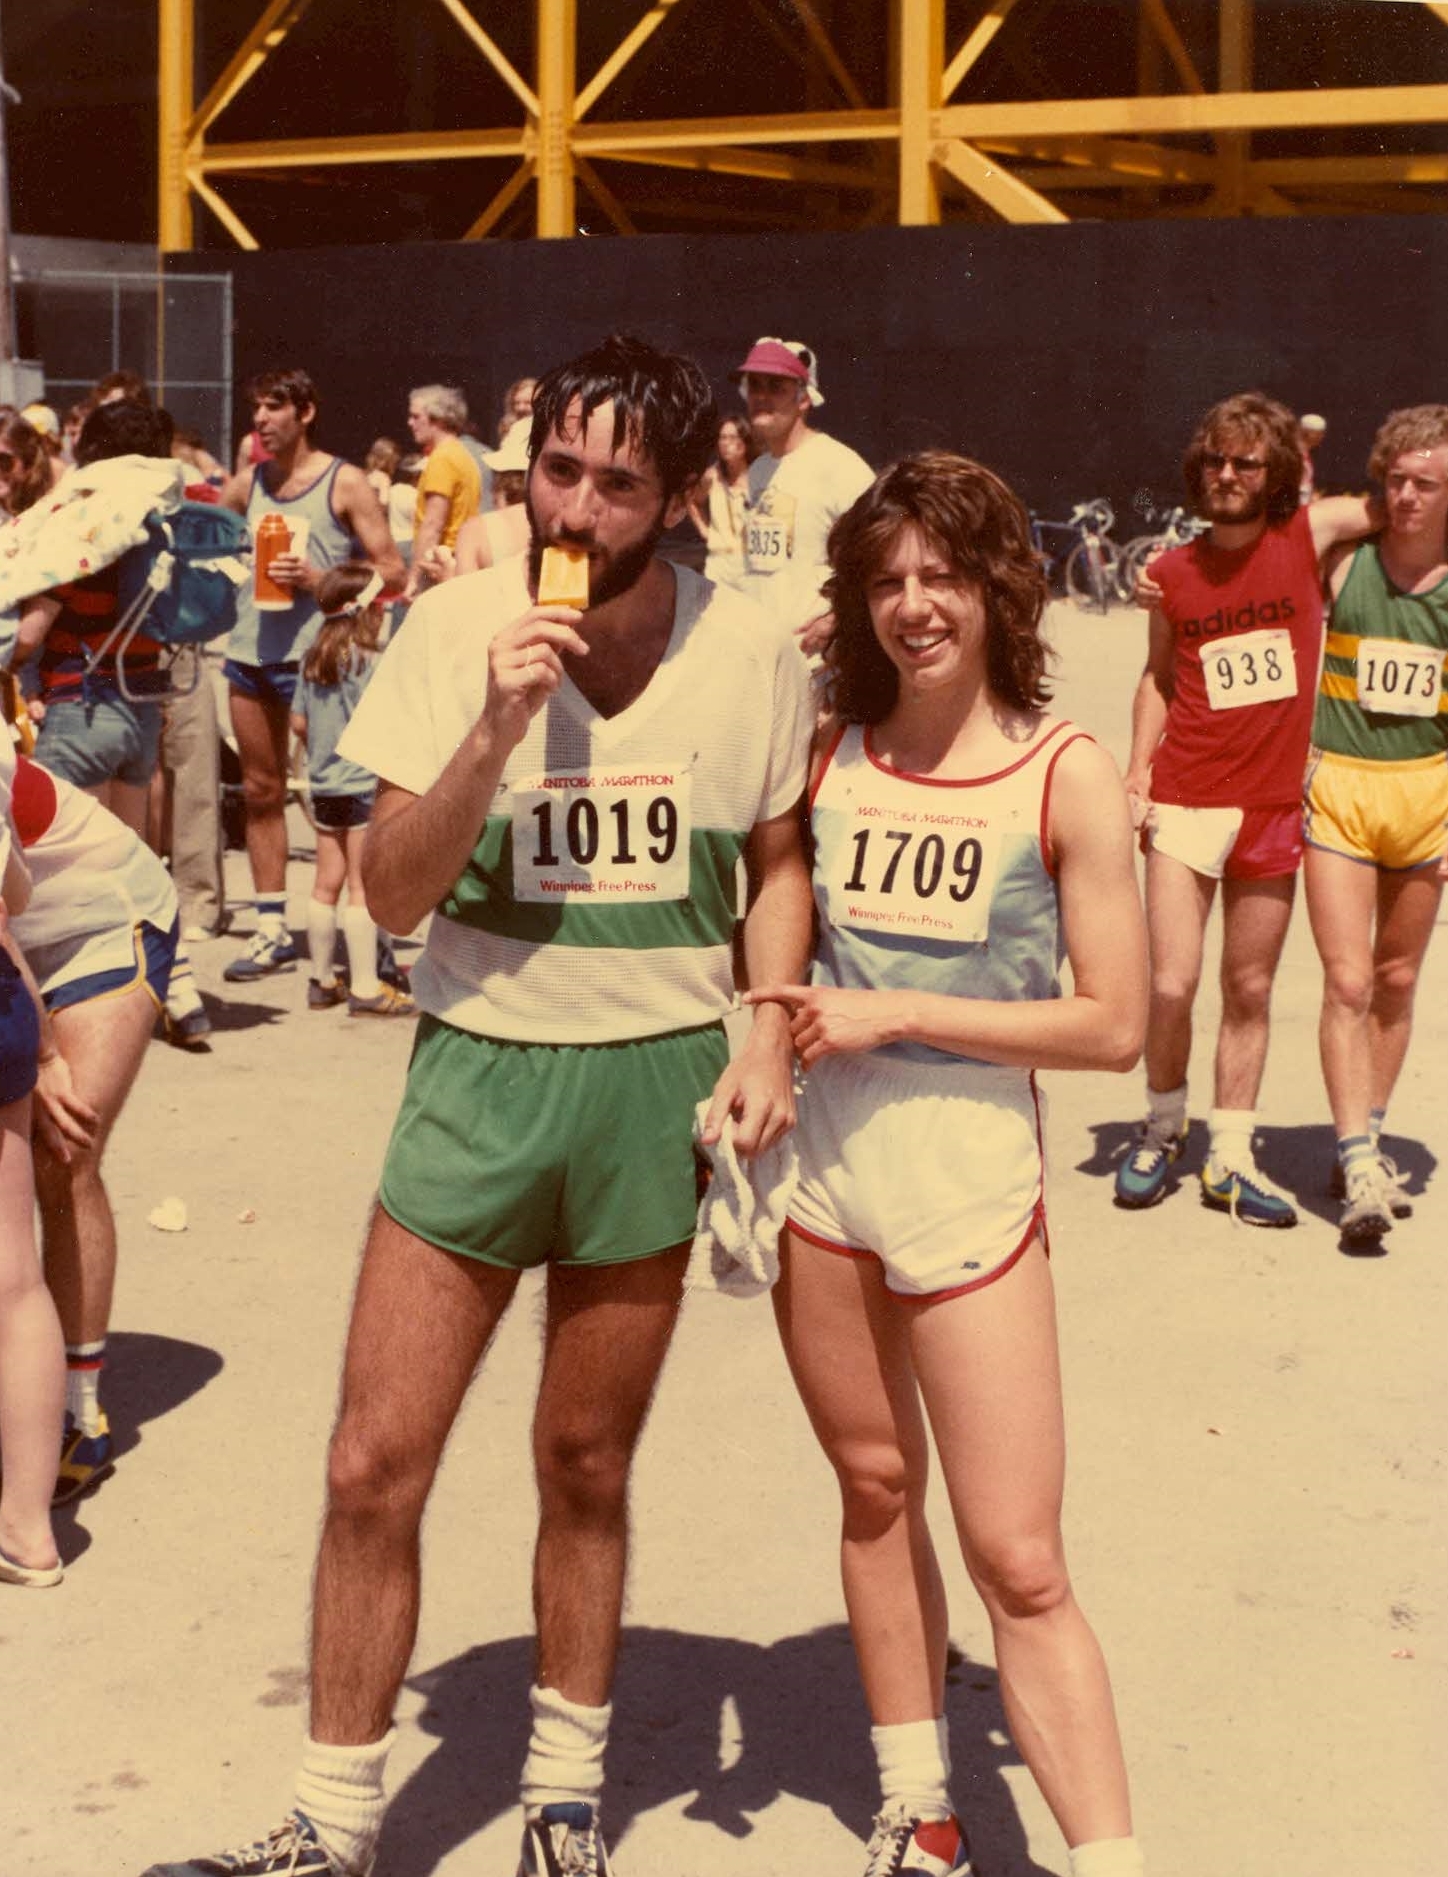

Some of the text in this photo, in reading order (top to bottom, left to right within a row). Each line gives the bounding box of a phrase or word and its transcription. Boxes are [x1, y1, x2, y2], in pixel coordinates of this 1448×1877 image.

[1183, 597, 1296, 638] adidas
[1216, 648, 1282, 690] 938
[1365, 659, 1436, 698] 1073
[529, 775, 674, 789] ANITOBA MARATHON
[532, 795, 678, 866] 1019
[919, 813, 989, 829] MARATHON
[843, 828, 983, 902] 1709
[540, 880, 656, 894] Winnipeg Free Press
[921, 914, 954, 929] Press
